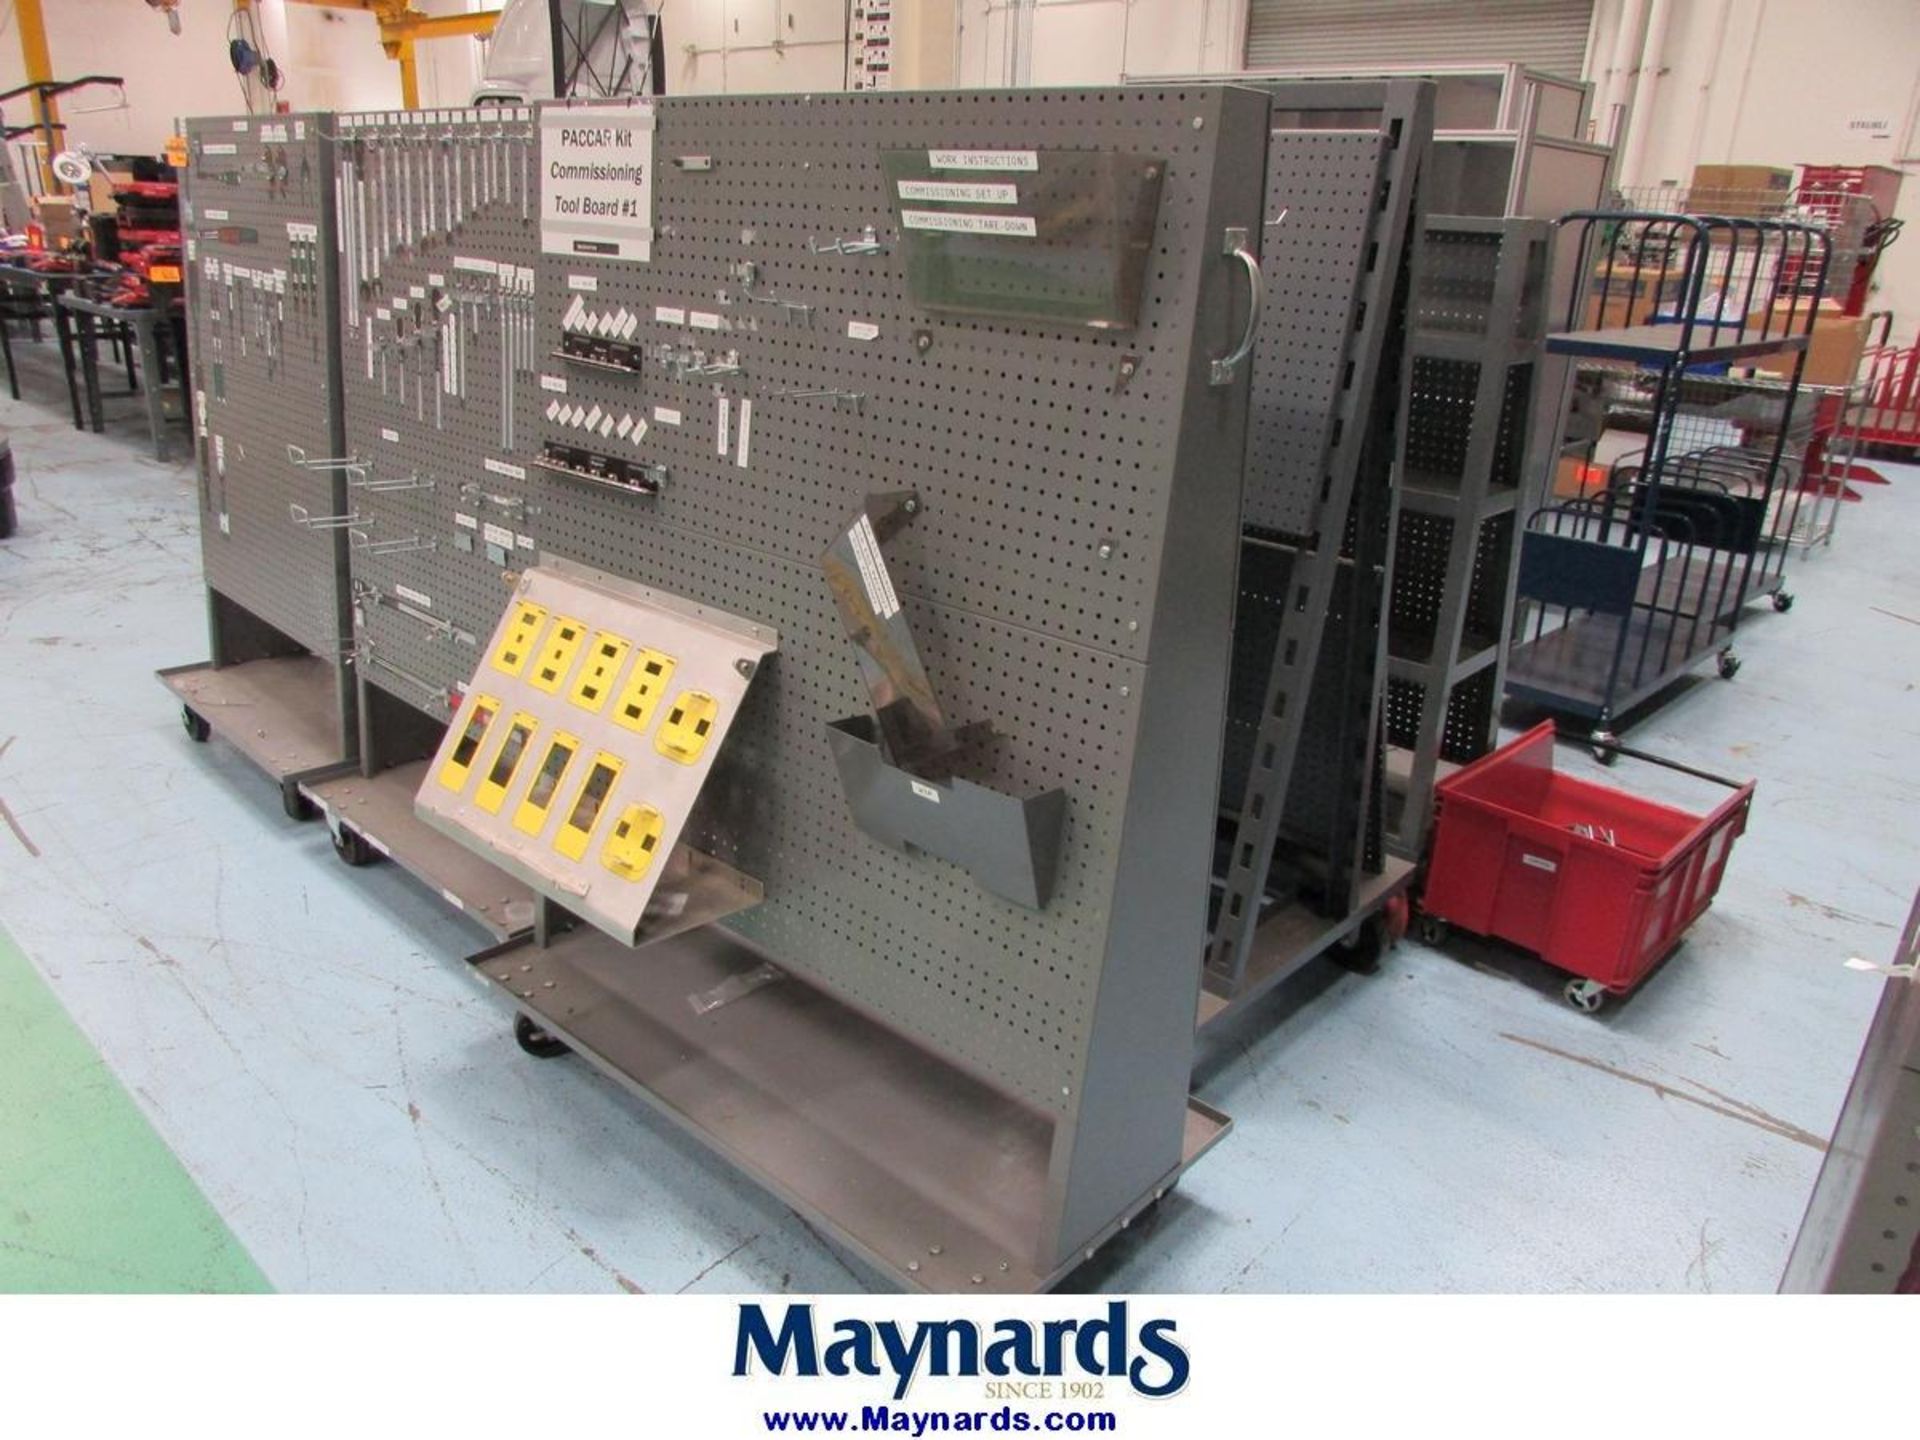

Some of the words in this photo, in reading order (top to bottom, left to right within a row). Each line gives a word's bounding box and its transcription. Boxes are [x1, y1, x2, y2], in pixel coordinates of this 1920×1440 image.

[561, 129, 612, 147] PACCAR
[615, 130, 633, 148] Kit
[935, 154, 958, 166] WORK
[963, 155, 1029, 167] INSTRUCTIONS
[550, 161, 643, 186] Commissioning
[904, 185, 972, 198] COMMISSIONING
[555, 195, 579, 215] Tool
[583, 197, 619, 217] Board
[622, 199, 638, 218] #1
[908, 214, 974, 229] COMMISSIONING
